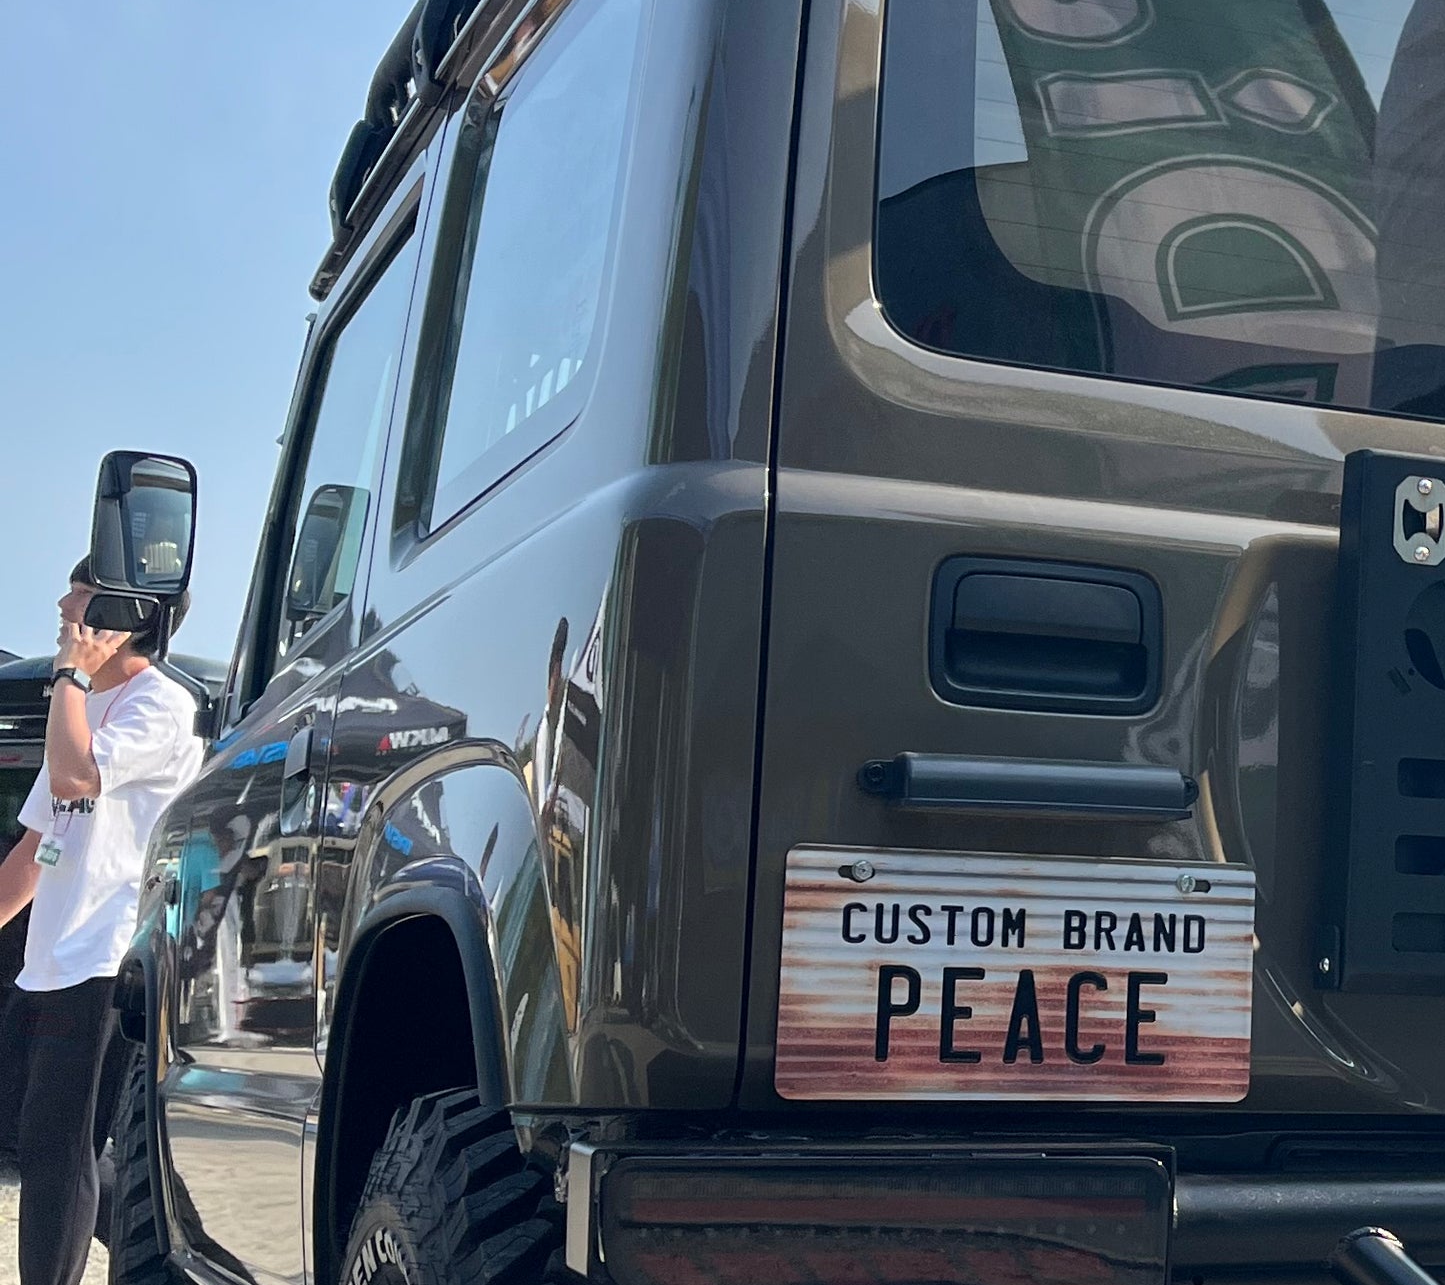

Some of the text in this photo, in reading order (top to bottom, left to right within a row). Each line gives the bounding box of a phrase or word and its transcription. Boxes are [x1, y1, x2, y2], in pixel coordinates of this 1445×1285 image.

[841, 902, 1206, 954] CUSTOM BRAND
[875, 964, 1169, 1066] PEACE
